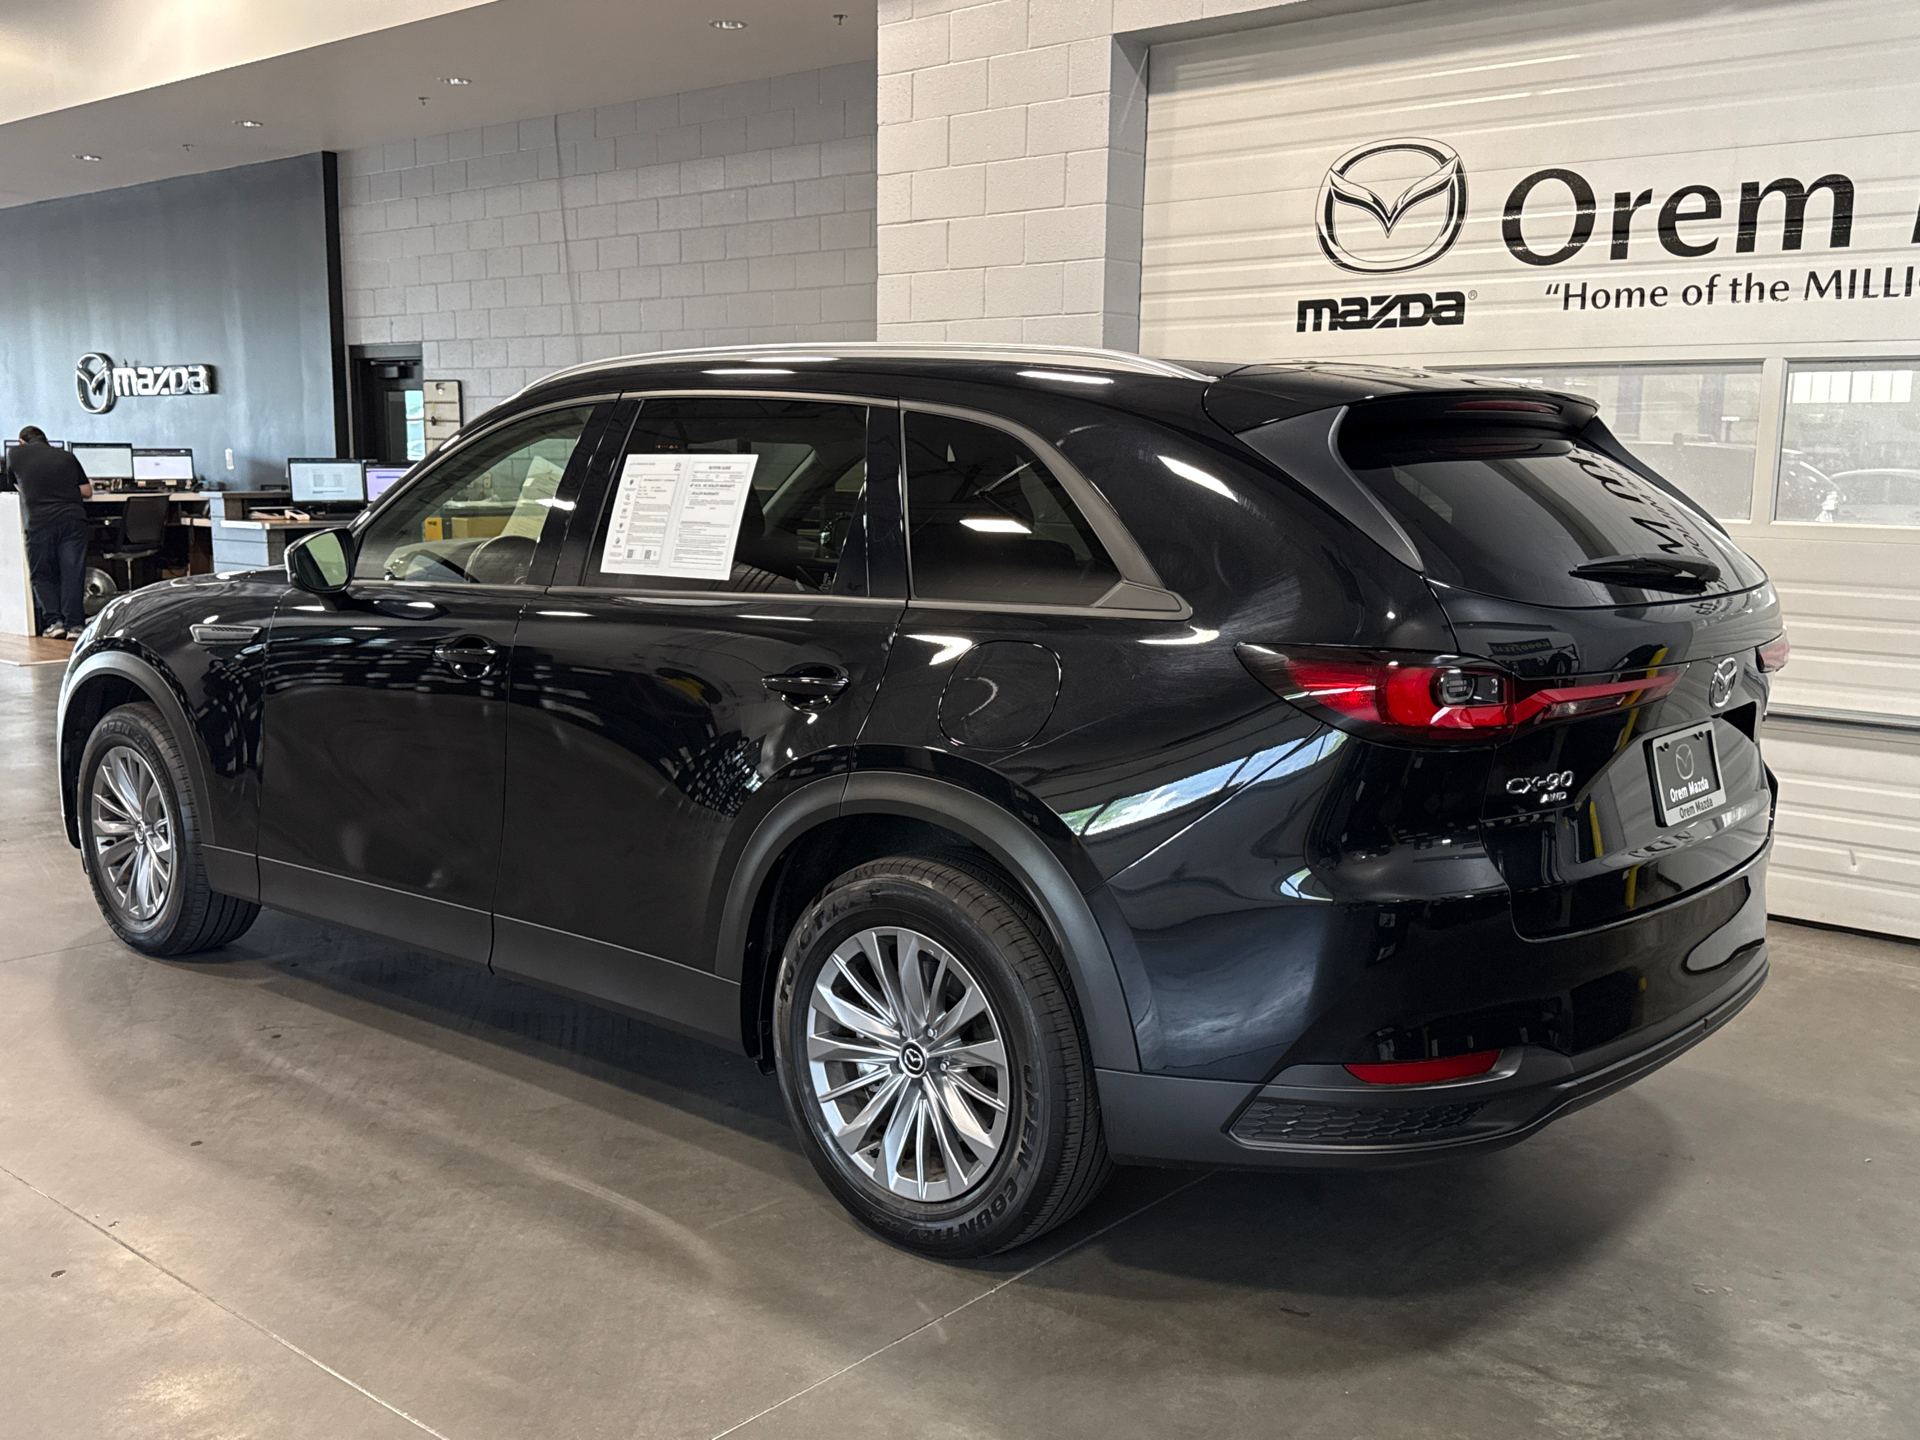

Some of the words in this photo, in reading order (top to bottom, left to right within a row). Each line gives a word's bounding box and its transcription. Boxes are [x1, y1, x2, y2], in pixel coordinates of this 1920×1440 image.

[1502, 168, 1855, 266] Orem
[1681, 273, 1720, 306] of
[1729, 272, 1790, 304] the
[1804, 265, 1920, 301] MILLI
[1506, 770, 1575, 794] CX-90
[1669, 786, 1689, 803] Orem
[1688, 779, 1710, 796] Mazda
[1679, 805, 1696, 819] Orem
[1695, 797, 1714, 812] Mazda
[1017, 1064, 1040, 1171] OPEN
[904, 1176, 1019, 1243] COUNTRY
